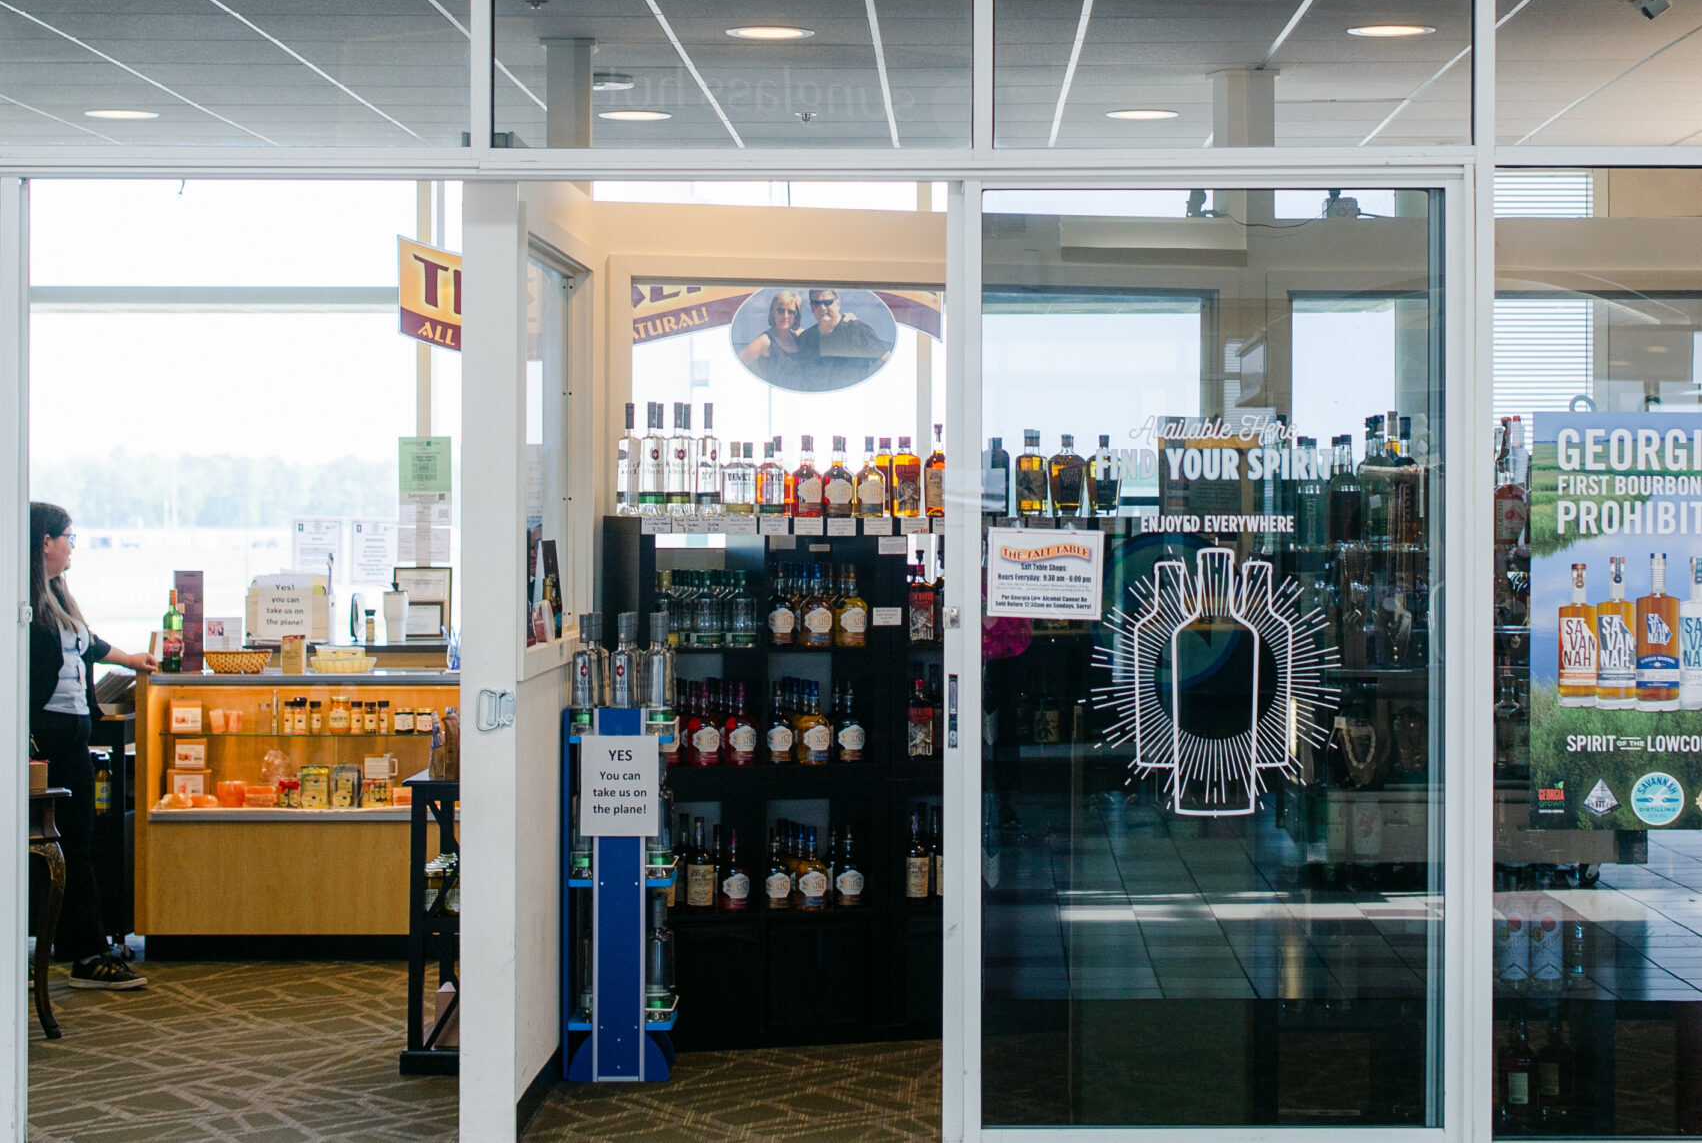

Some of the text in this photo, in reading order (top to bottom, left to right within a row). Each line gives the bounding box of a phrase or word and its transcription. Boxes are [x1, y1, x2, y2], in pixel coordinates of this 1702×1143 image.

[417, 321, 456, 346] ALL
[1128, 414, 1299, 446] Available Here
[1095, 448, 1156, 481] FIND
[1165, 448, 1240, 481] YOUR
[1247, 448, 1331, 481] SPIRIT
[1558, 475, 1702, 496] FIRST BOURBON
[1141, 515, 1294, 533] ENJOYED EVERYWHERE
[1003, 544, 1088, 559] THE SALT TABLE
[1021, 563, 1032, 571] Salt
[1033, 563, 1047, 571] Table
[998, 573, 1013, 581] Hours
[275, 583, 295, 591] Yes!
[280, 618, 303, 626] plane!
[1565, 619, 1583, 635] SA
[1601, 616, 1622, 635] SA
[1569, 635, 1596, 651] VAN
[1606, 633, 1636, 651] VAN
[1563, 650, 1591, 667] NAH
[1601, 650, 1631, 668] NAH
[1566, 735, 1616, 753] SPIRIT
[1647, 735, 1702, 753] LOWCO
[608, 749, 633, 762] YES
[599, 770, 641, 781] You can
[593, 787, 647, 798] take us on
[1637, 776, 1679, 795] SAVANNAH
[1538, 788, 1565, 801] GEORGIA
[593, 803, 647, 817] the plane!
[1538, 800, 1565, 808] grown
